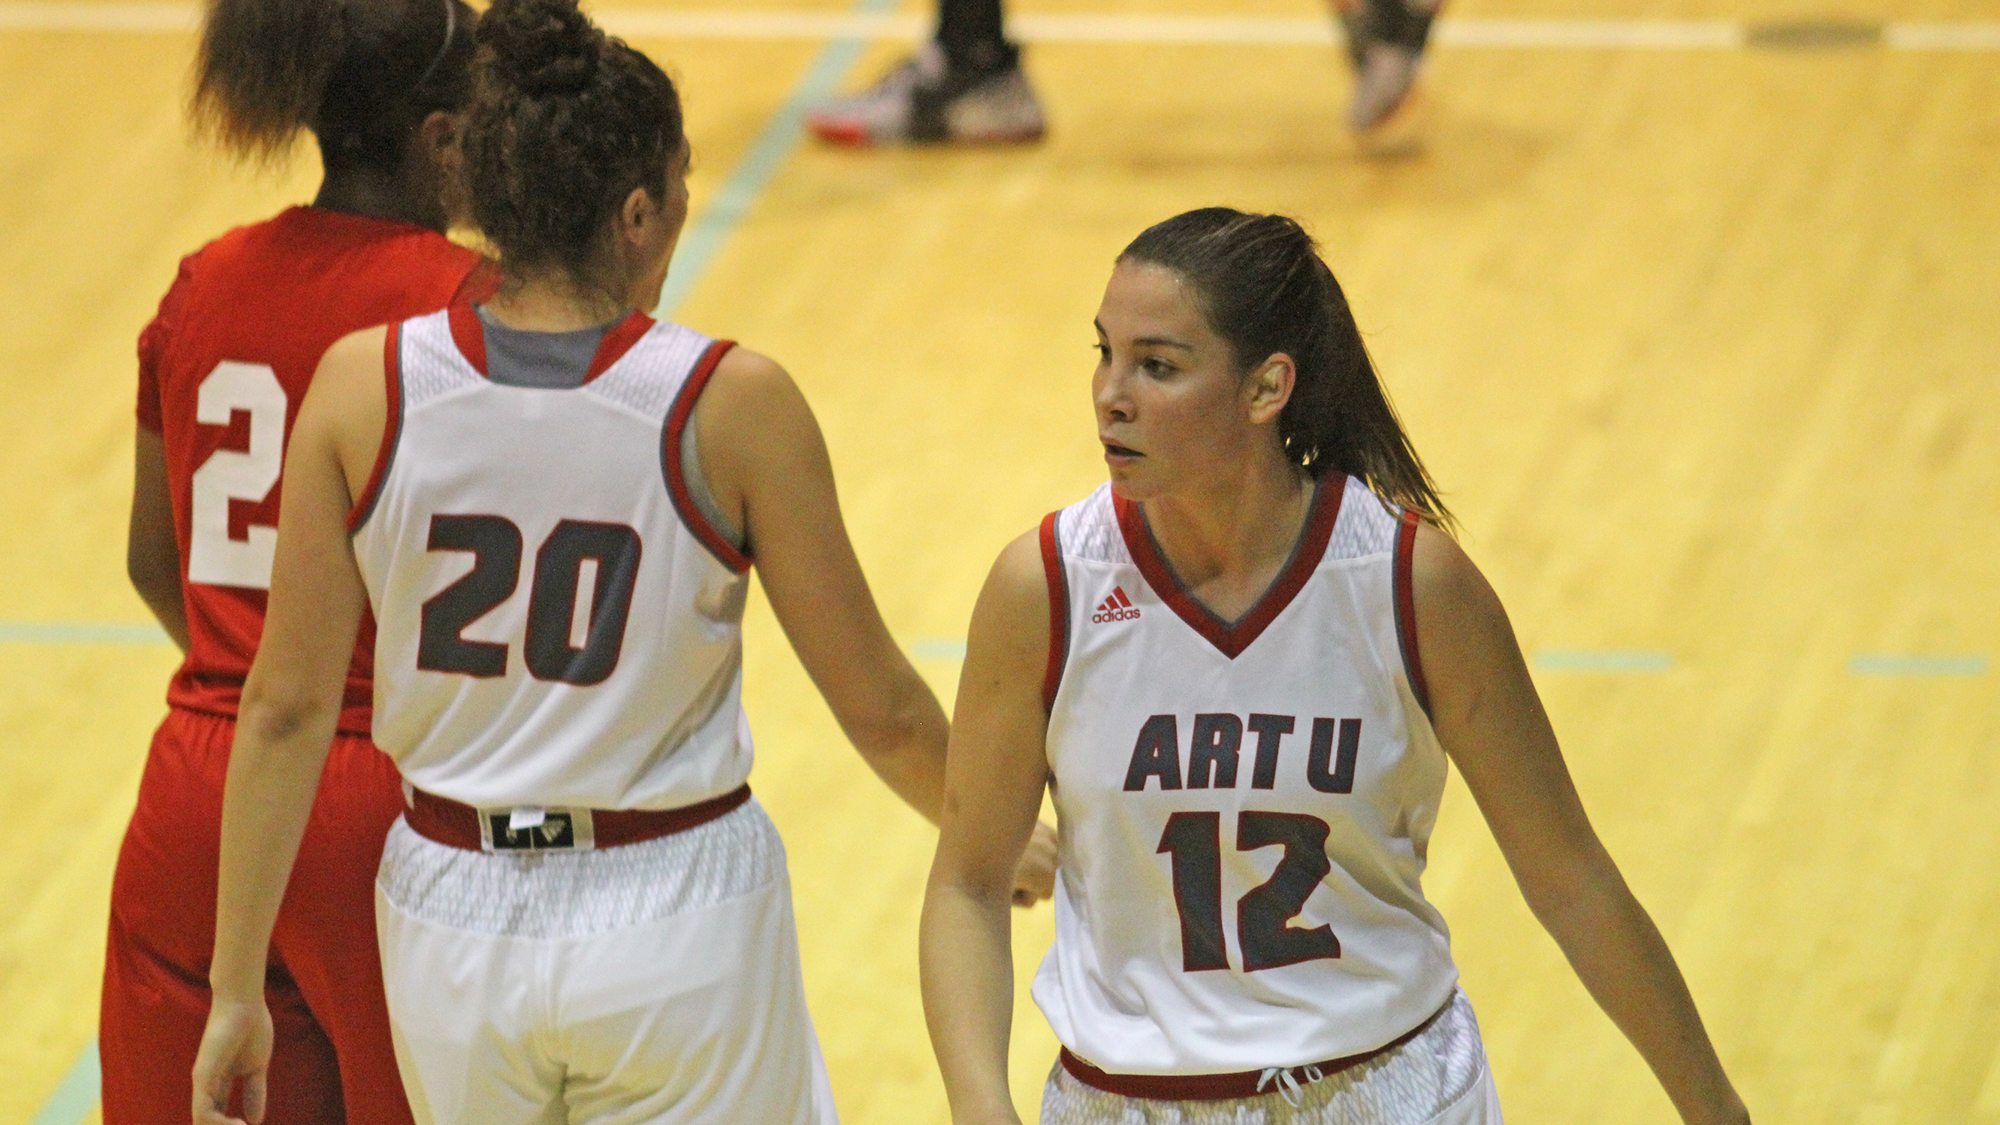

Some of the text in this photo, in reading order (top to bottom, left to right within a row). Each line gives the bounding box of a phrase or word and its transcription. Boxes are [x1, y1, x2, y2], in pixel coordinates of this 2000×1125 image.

[188, 360, 288, 589] 2
[417, 513, 642, 687] 20
[1092, 607, 1141, 624] adidas
[1156, 810, 1341, 973] 12
